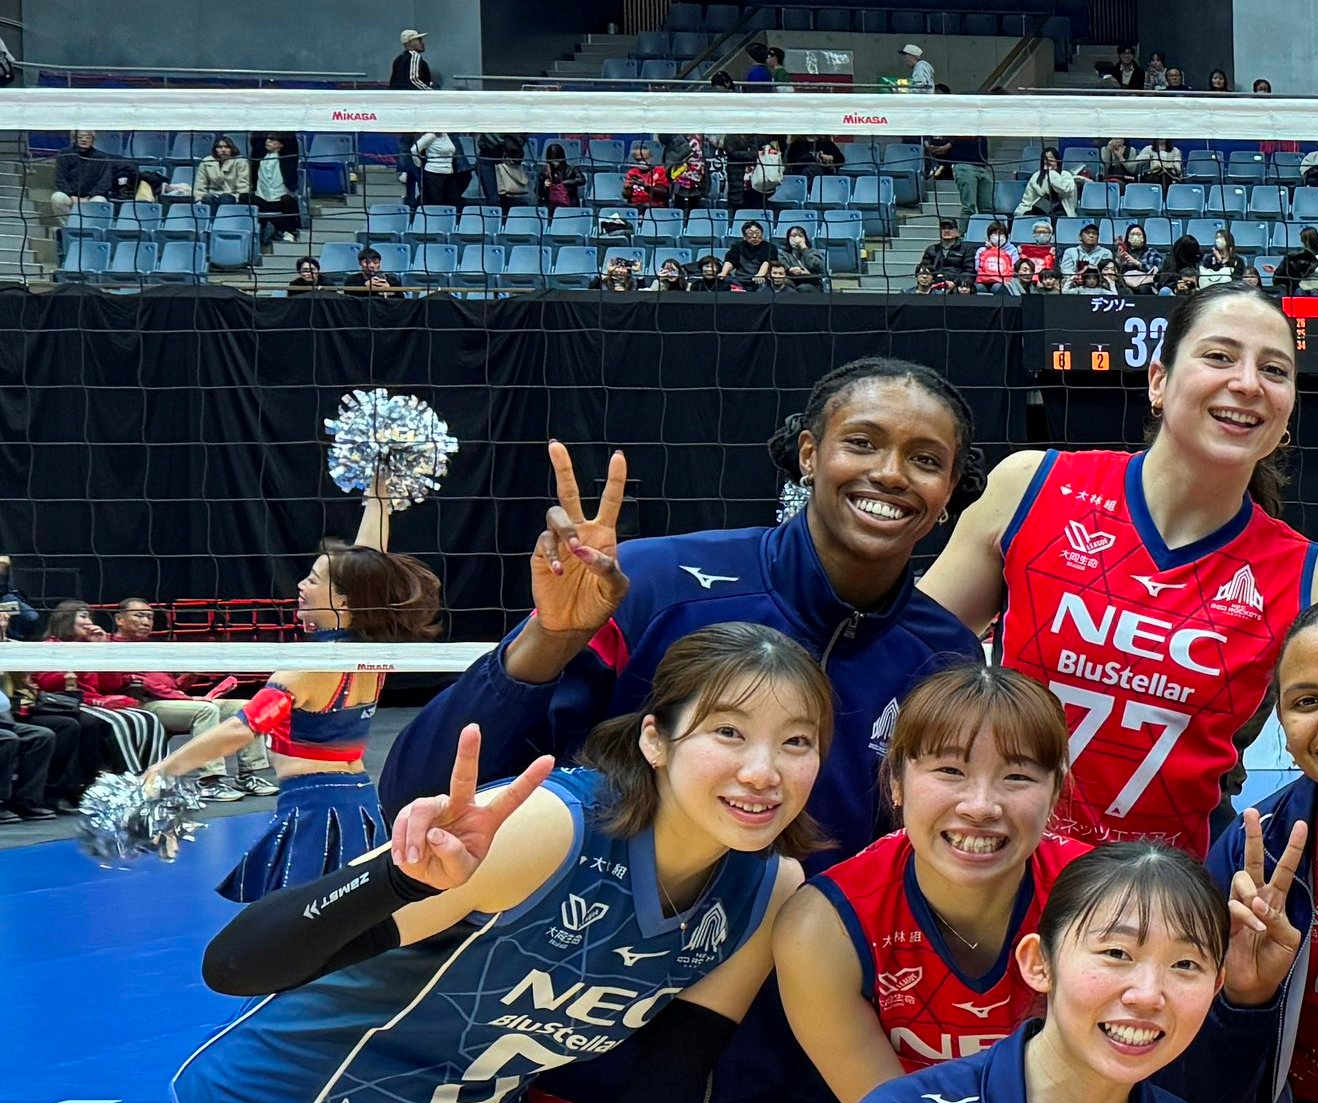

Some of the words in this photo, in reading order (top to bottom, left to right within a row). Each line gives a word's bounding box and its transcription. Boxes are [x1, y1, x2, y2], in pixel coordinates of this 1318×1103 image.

[1091, 297, 1135, 312] デンソー
[1050, 592, 1227, 677] NEC
[1057, 650, 1195, 703] BluStellar
